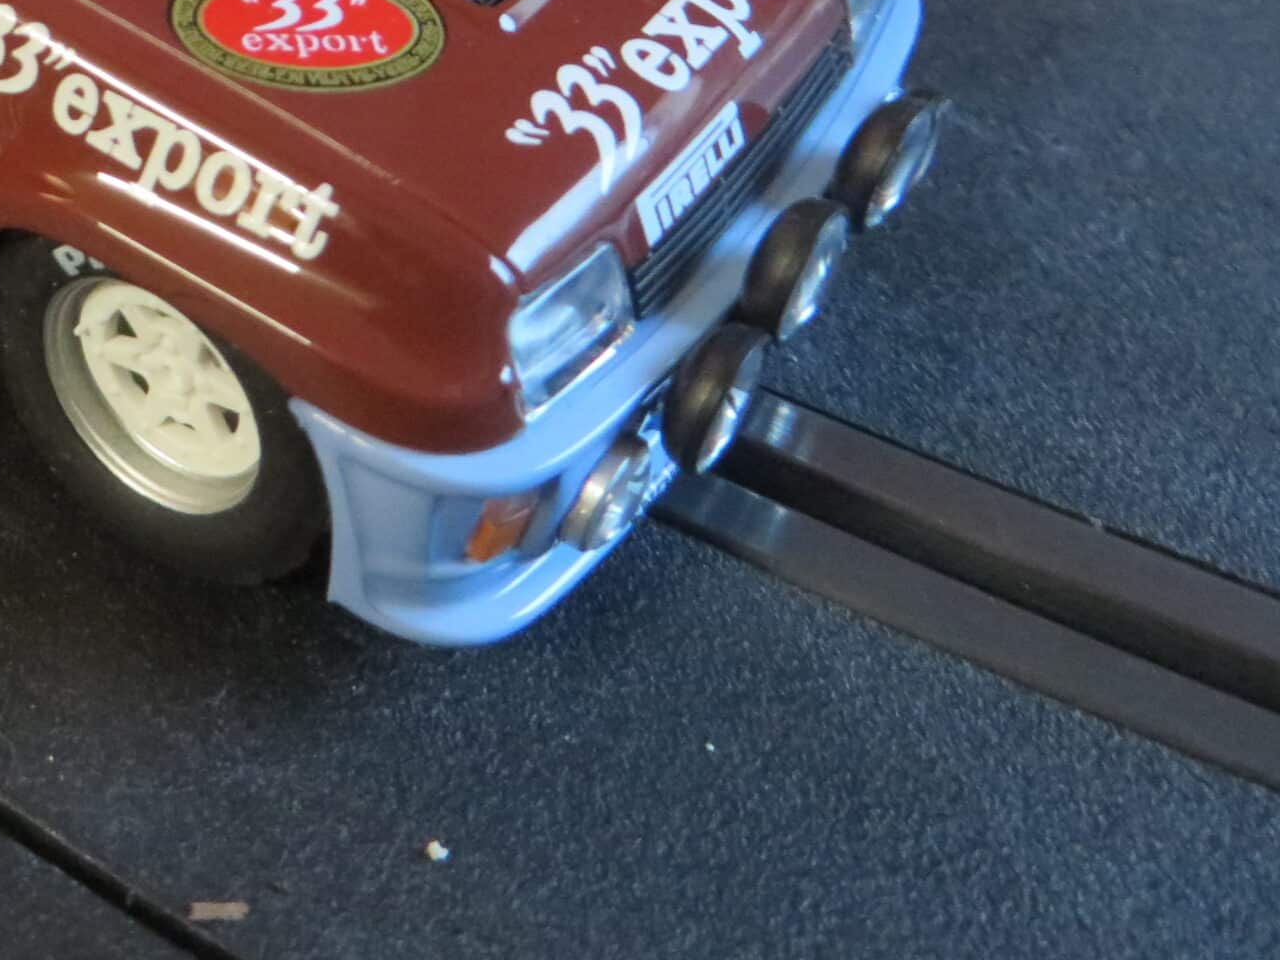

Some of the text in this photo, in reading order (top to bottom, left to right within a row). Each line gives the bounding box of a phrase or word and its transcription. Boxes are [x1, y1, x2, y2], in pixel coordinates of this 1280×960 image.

[241, 29, 389, 59] export
[51, 71, 341, 261] export
[634, 100, 747, 247] PIRELLI
